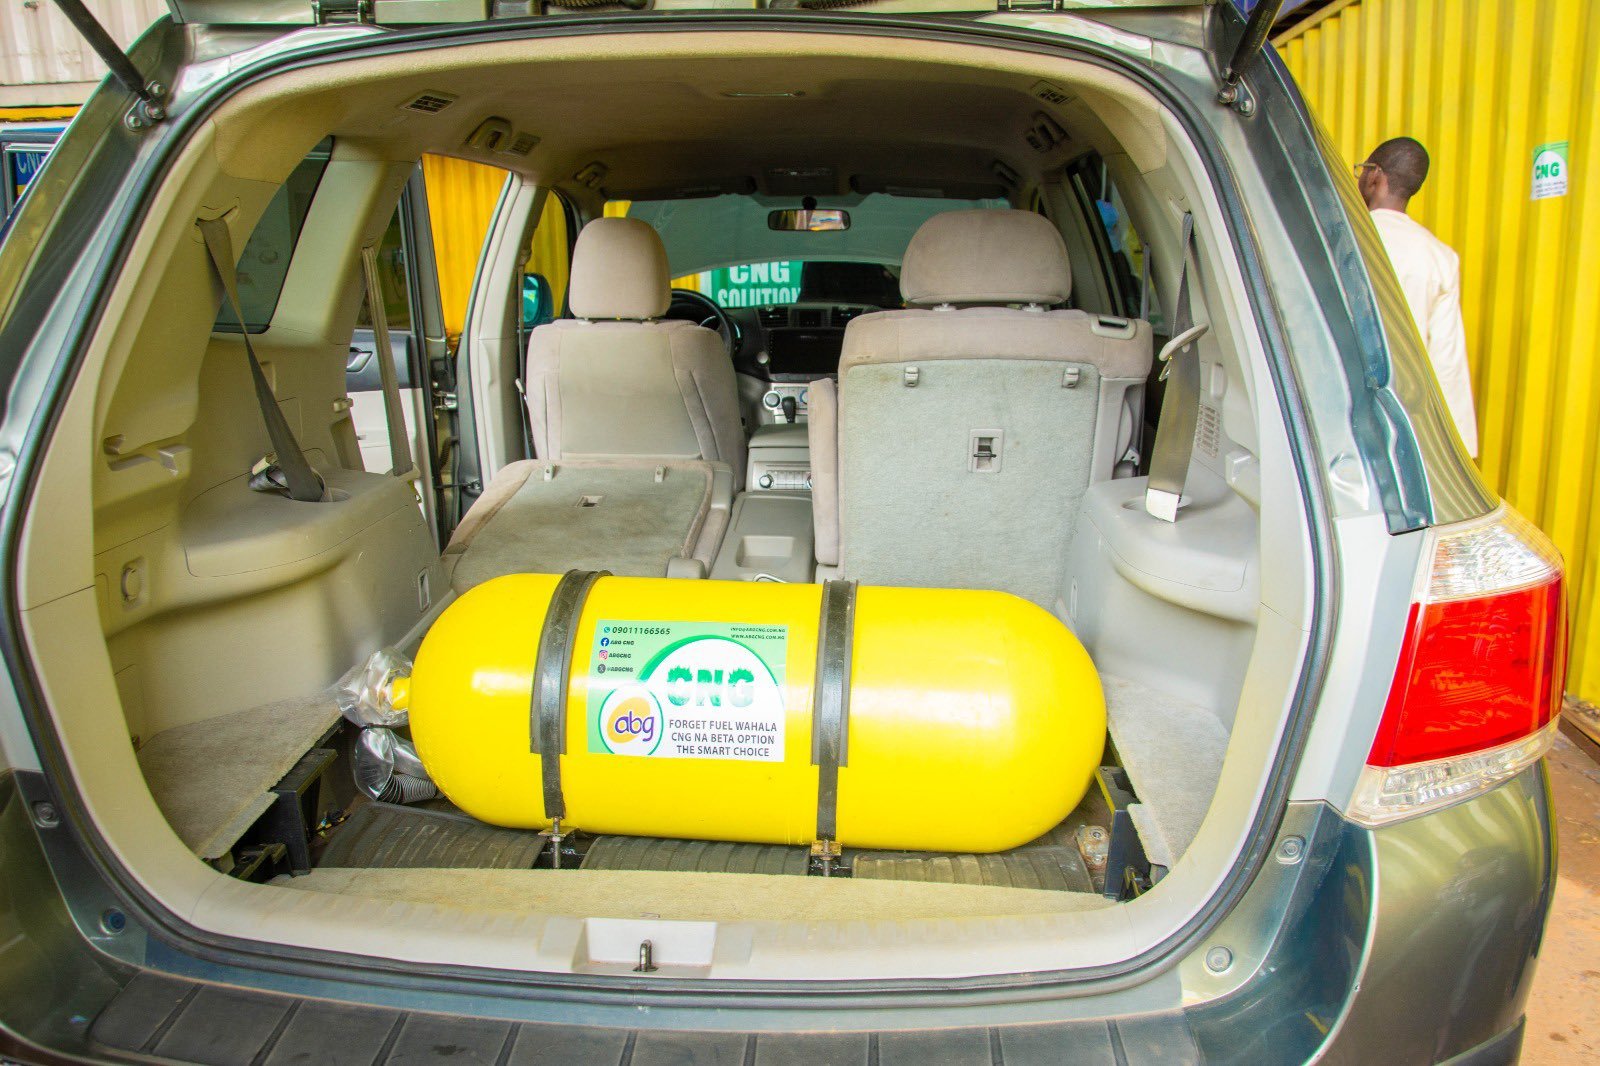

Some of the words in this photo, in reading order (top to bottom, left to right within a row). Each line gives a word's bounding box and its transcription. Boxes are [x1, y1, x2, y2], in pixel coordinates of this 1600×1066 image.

[1536, 162, 1560, 180] CNG
[729, 261, 790, 284] CNG
[612, 626, 671, 635] 09011166565
[667, 665, 755, 708] CNG
[614, 711, 655, 742] abg
[669, 719, 707, 730] FORGET
[709, 721, 733, 731] FUEL
[735, 721, 777, 732] WAHALA
[671, 732, 692, 742] CNG
[694, 733, 708, 743] NA
[711, 733, 735, 744] BETA
[738, 734, 775, 745] OPTION
[676, 744, 695, 754] THE
[698, 746, 731, 756] SMART
[733, 747, 770, 757] CHOICE
